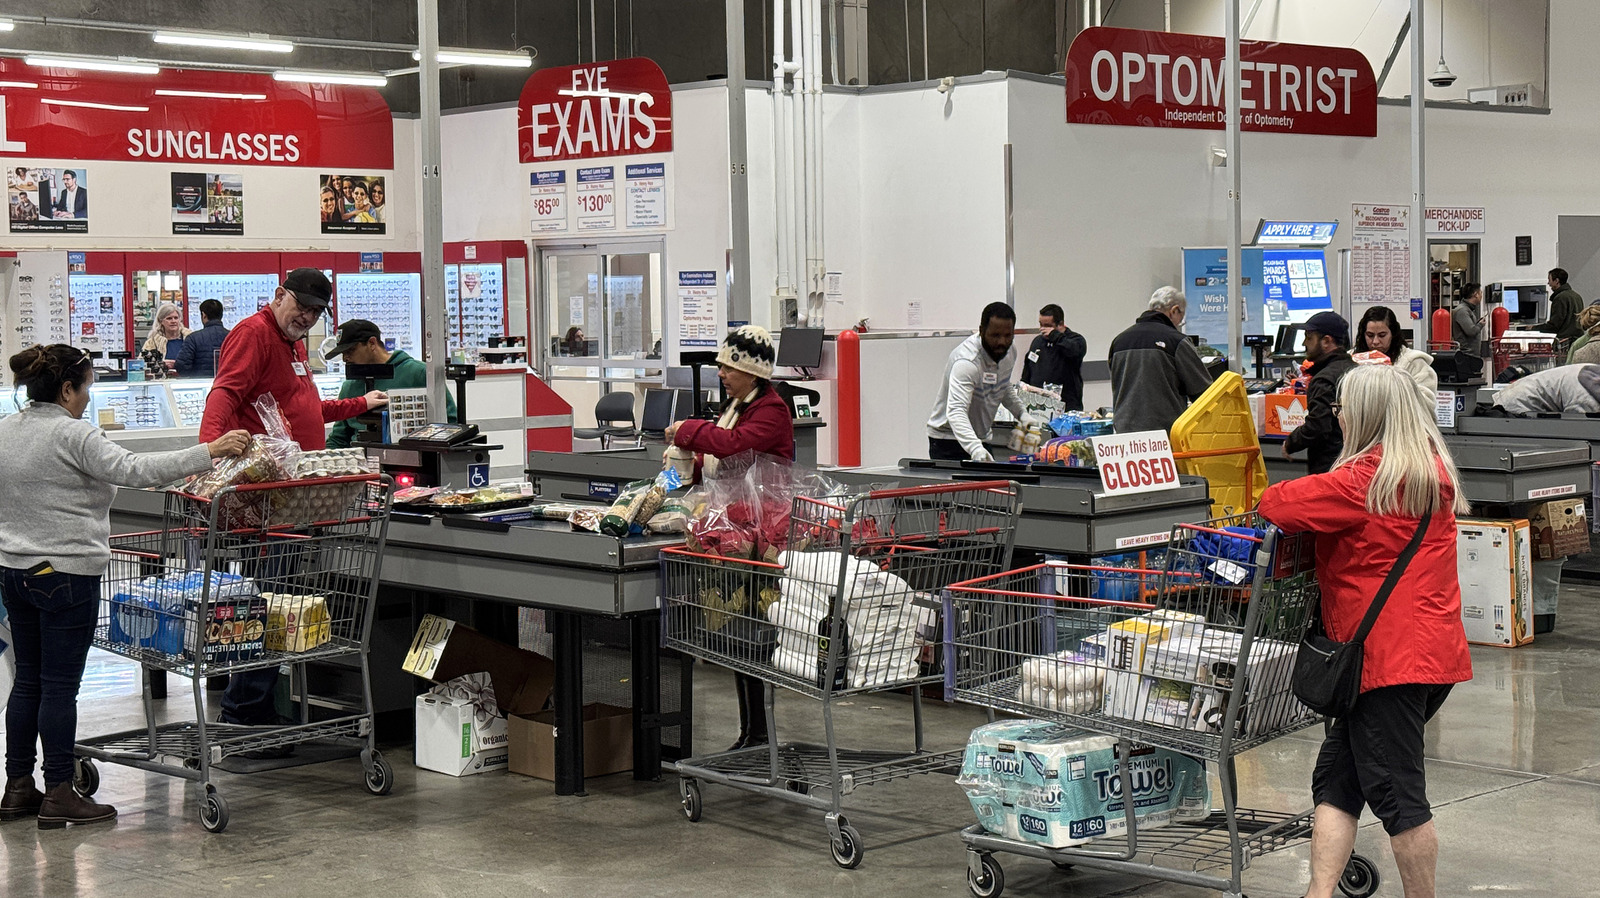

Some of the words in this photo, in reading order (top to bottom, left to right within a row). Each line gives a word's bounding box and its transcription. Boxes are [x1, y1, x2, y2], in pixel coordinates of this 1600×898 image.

[572, 66, 609, 97] EYE
[1090, 50, 1357, 115] OPTOMETRIST
[532, 92, 656, 158] EXAMS
[1165, 108, 1215, 124] Independent
[1217, 111, 1243, 124] Dor
[1244, 113, 1252, 124] of
[1254, 114, 1294, 129] Optometry
[127, 128, 300, 163] SUNGLASSES
[1425, 209, 1482, 220] MERCHANDISE
[1264, 224, 1292, 235] APPLY
[1292, 224, 1314, 235] HERE
[1438, 221, 1470, 231] PICK-UP
[1264, 266, 1286, 275] EWARDS
[1272, 275, 1288, 284] TIME
[1200, 304, 1221, 312] Were
[1098, 444, 1128, 458] Sorry,
[1130, 440, 1147, 454] this
[1149, 439, 1168, 452] lane
[1103, 458, 1175, 490] CLOSED
[1121, 538, 1135, 546] LEAVE
[1136, 537, 1149, 545] HEAVY
[1150, 535, 1163, 544] ITEMS
[482, 734, 508, 745] Organic
[990, 756, 1024, 776] Towel
[1115, 759, 1160, 773] PEMIUM
[1093, 758, 1174, 800] Towel
[1022, 816, 1029, 825] 12
[1031, 818, 1046, 830] 160
[1072, 823, 1082, 833] 12
[1086, 820, 1103, 831] 160
